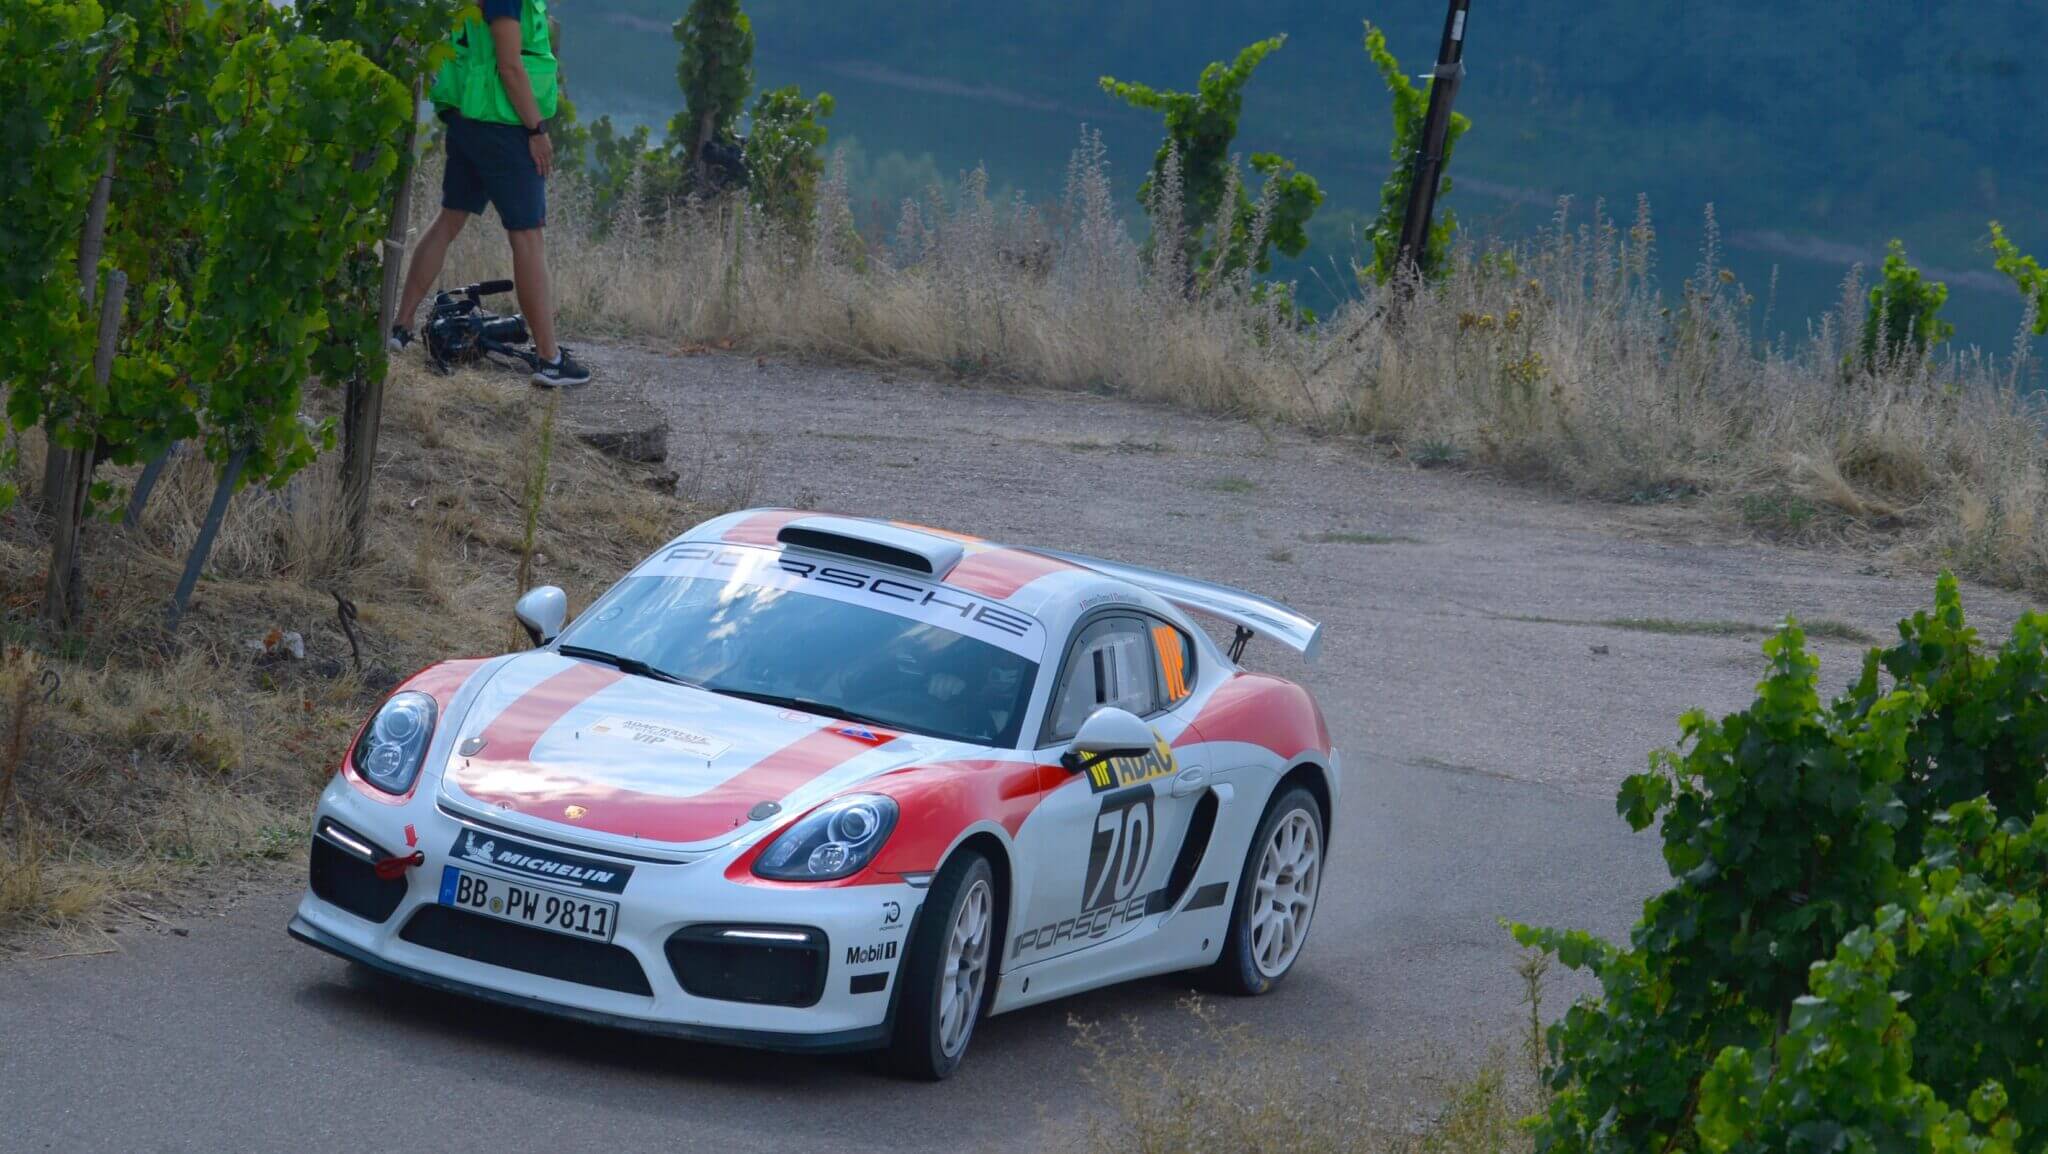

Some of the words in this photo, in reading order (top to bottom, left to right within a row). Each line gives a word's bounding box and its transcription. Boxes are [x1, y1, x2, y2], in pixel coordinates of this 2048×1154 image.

[663, 549, 1033, 637] PORSCHE
[632, 732, 666, 744] VIP
[497, 851, 615, 883] MICHELIN
[1085, 802, 1149, 912] 70
[456, 874, 489, 908] BB
[506, 887, 540, 921] PW
[544, 897, 608, 937] 9811
[1018, 895, 1147, 953] PORSCHE
[846, 943, 884, 965] Mobil
